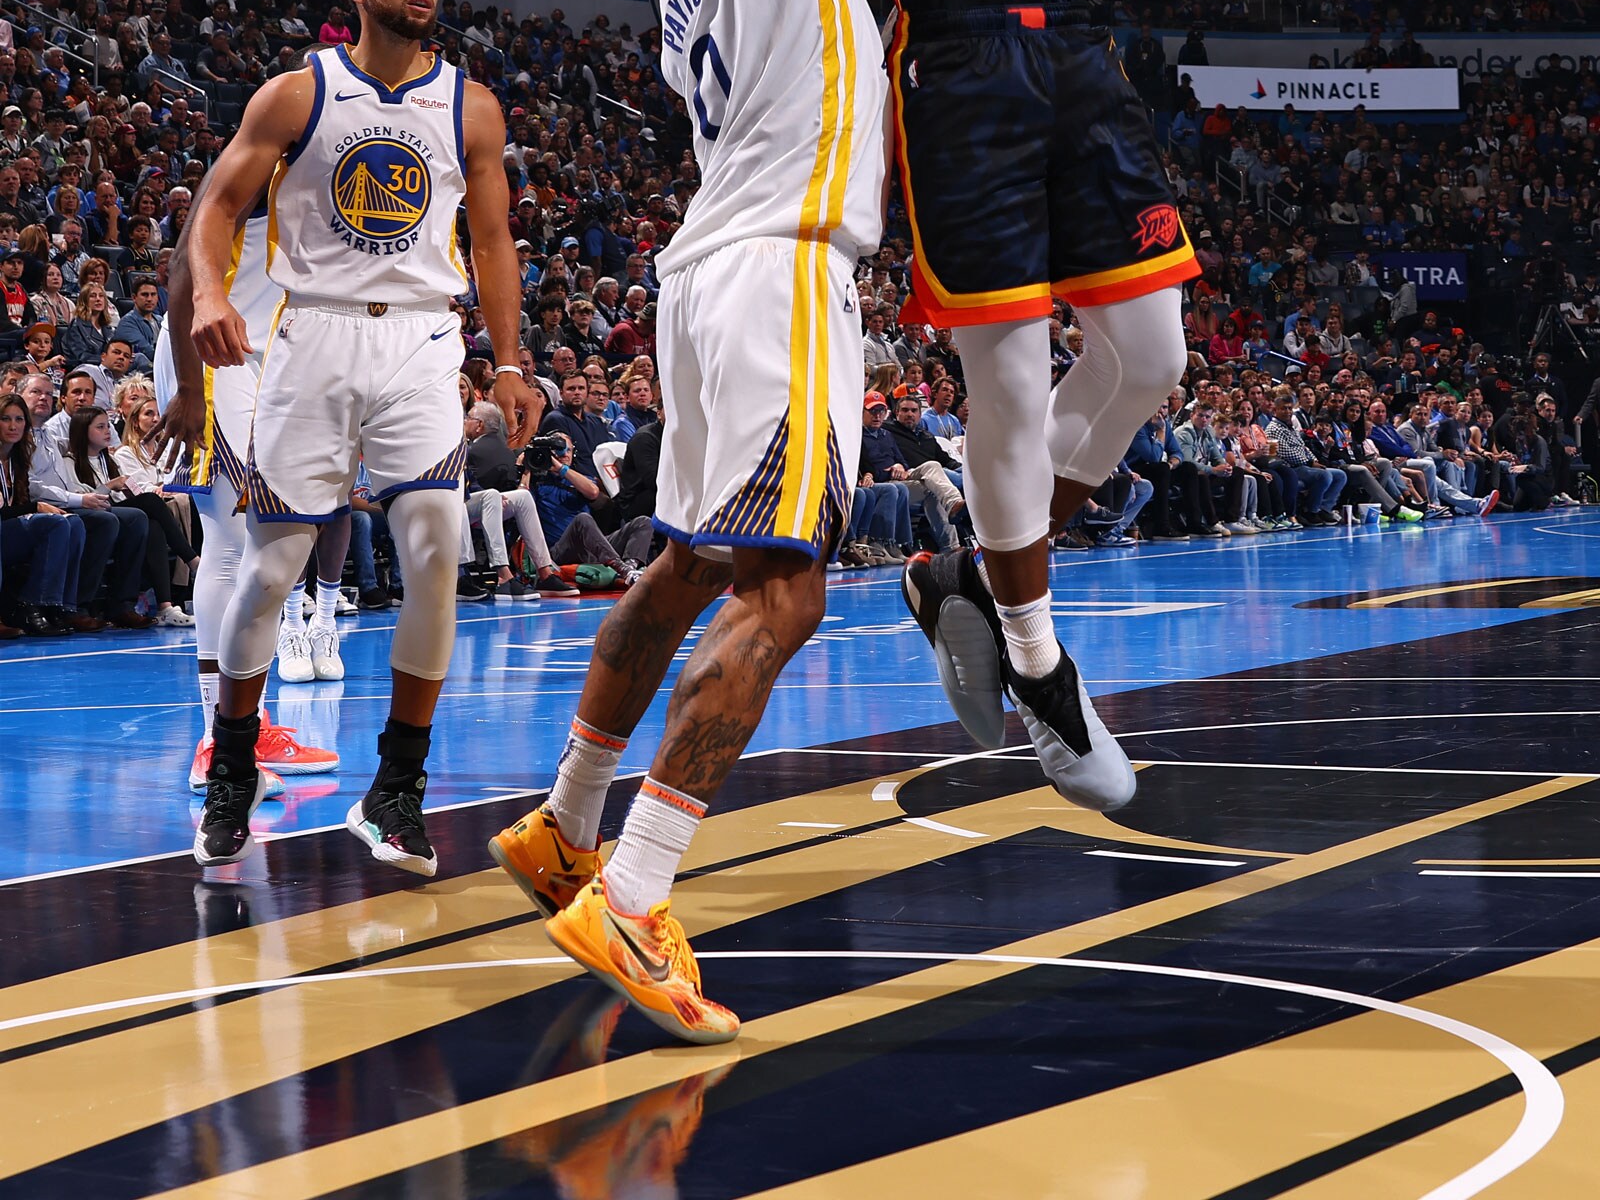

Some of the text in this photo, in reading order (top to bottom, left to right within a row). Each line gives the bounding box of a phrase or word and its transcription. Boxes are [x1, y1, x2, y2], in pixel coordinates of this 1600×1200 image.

[410, 96, 449, 109] Rakuten
[1277, 81, 1380, 99] PINNACLE
[335, 126, 434, 162] GOLDEN STATE
[387, 164, 421, 194] 30
[330, 214, 424, 256] WARRIOR
